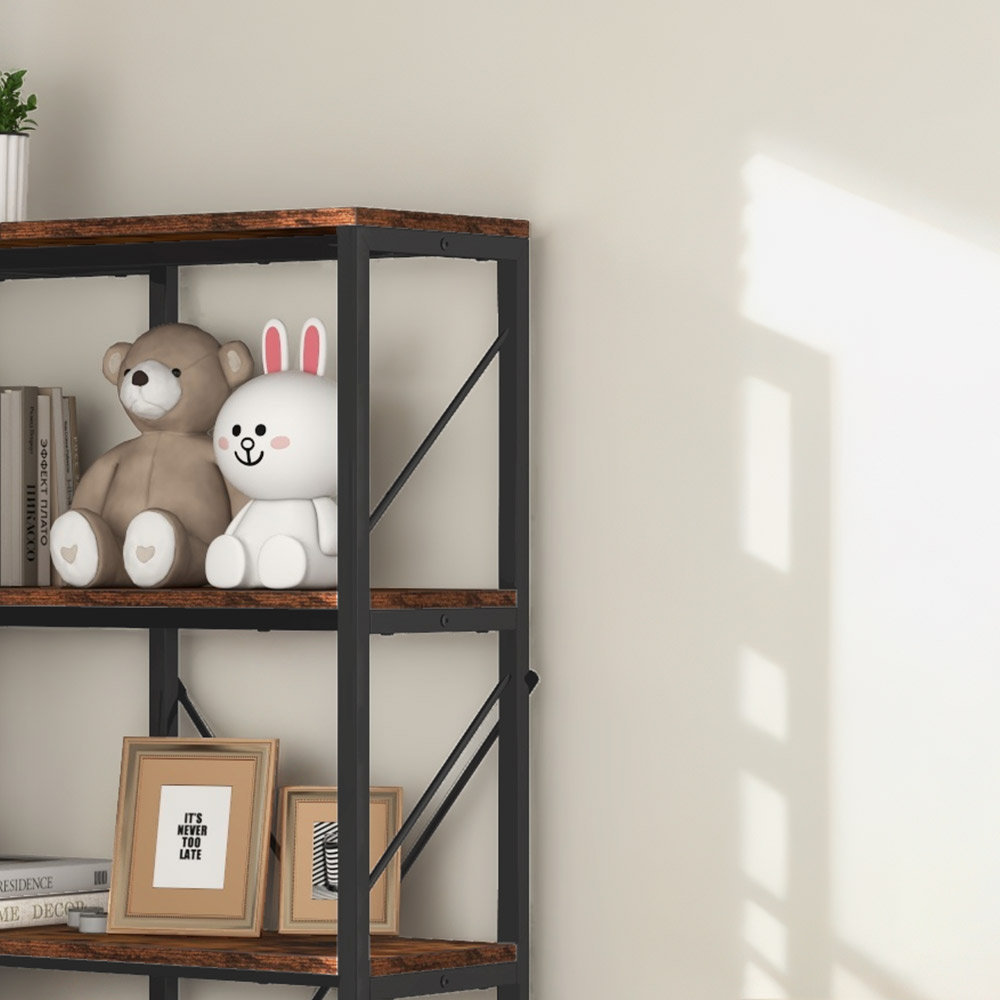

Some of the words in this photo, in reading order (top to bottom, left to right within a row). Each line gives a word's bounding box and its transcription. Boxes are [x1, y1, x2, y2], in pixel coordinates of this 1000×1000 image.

[40, 439, 48, 493] ЭФФЕКТ
[26, 484, 35, 562] ПИКАССО
[40, 500, 48, 546] ПЛАТО
[184, 813, 202, 823] IT'S
[178, 825, 207, 835] NEVER
[182, 837, 201, 848] TOO
[180, 849, 201, 860] LATE
